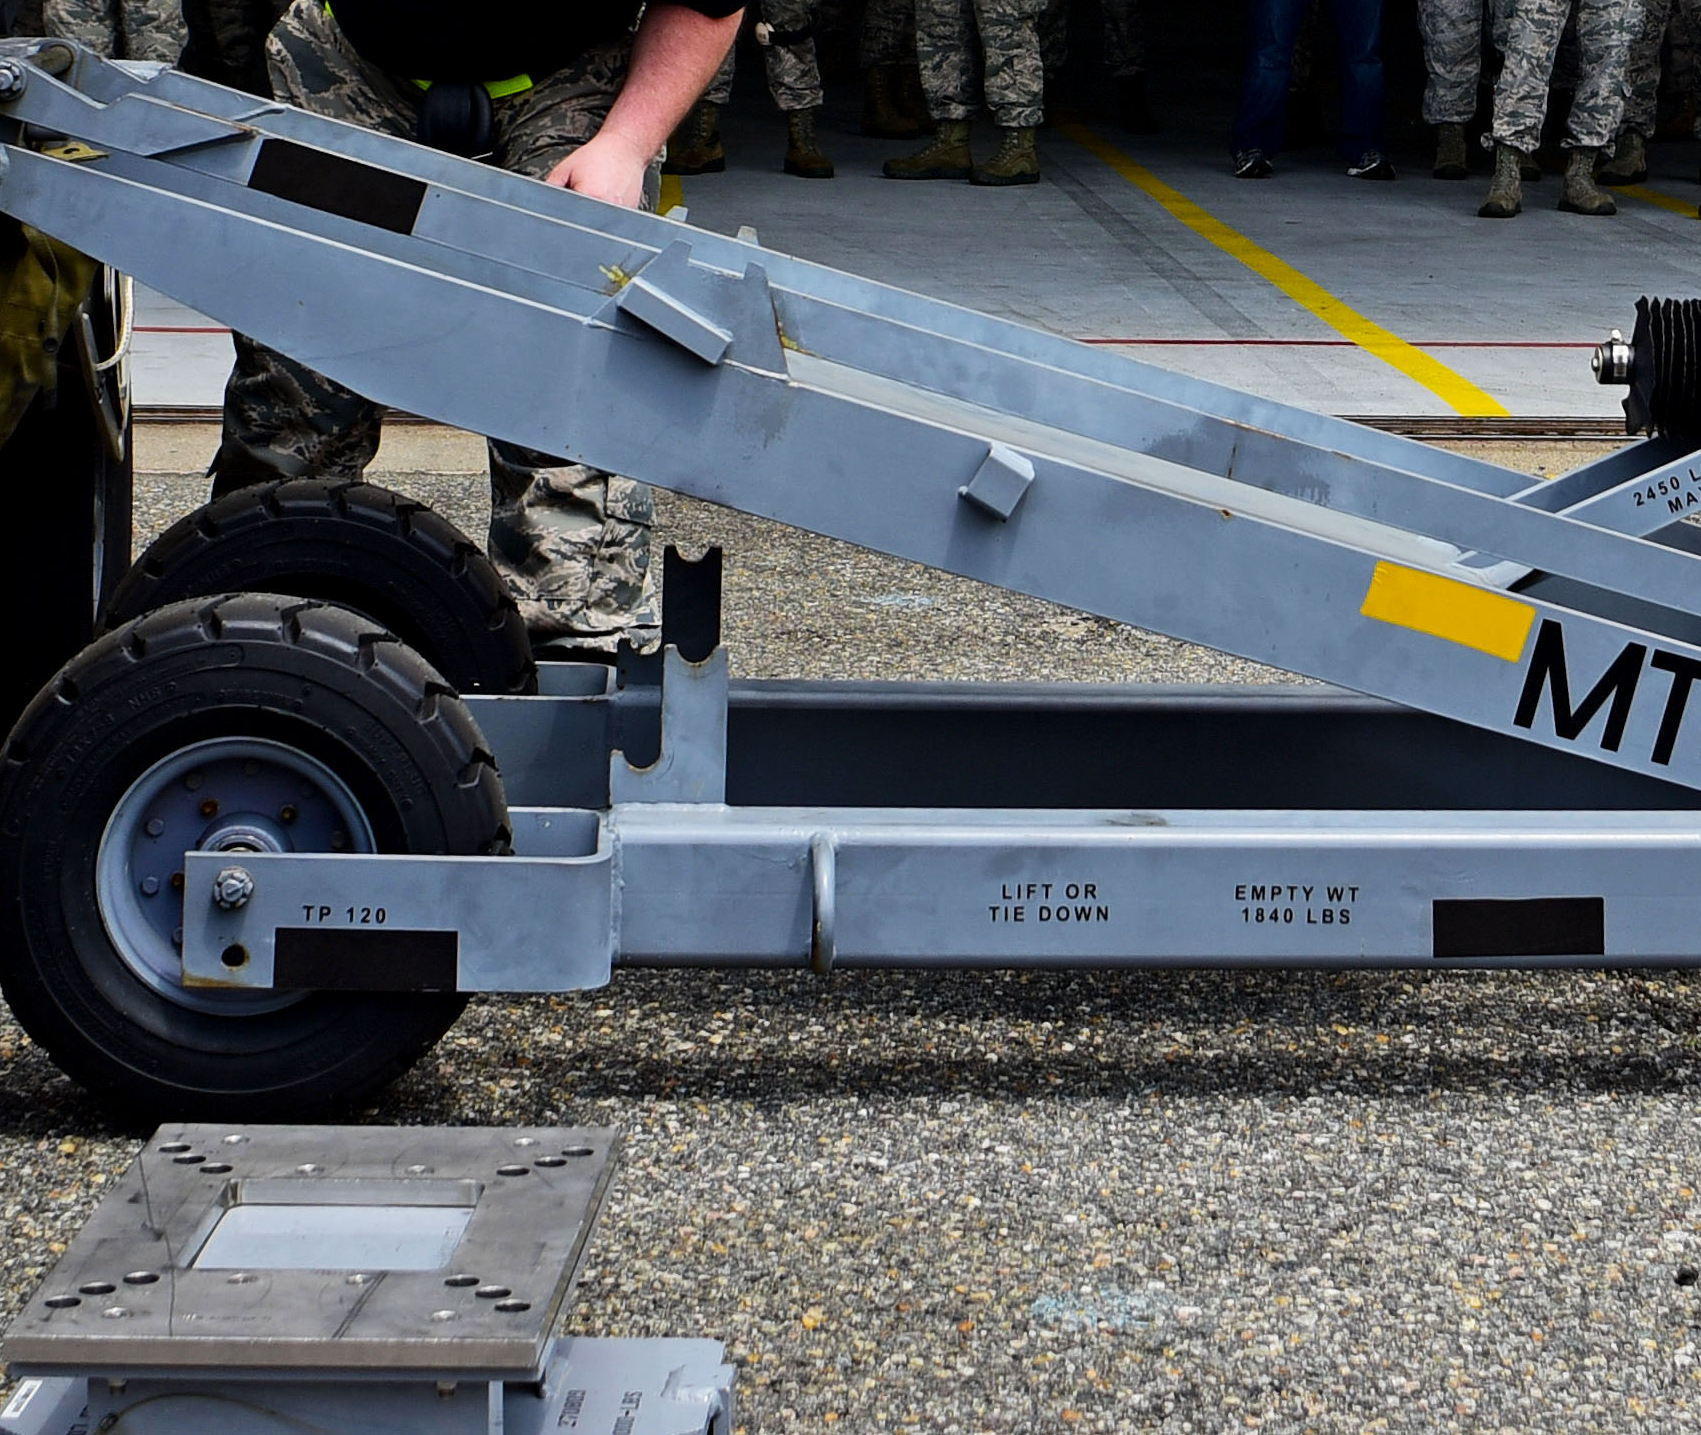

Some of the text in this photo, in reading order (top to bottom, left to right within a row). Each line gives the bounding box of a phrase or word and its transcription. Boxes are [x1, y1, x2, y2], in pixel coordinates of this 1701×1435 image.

[1633, 476, 1680, 506] 2450
[1002, 883, 1097, 900] LIFT OR
[1235, 884, 1359, 902] EMPTY WT
[302, 905, 387, 924] TP 120
[988, 905, 1109, 922] TIE DOWN
[1242, 907, 1351, 924] 1840 LBS
